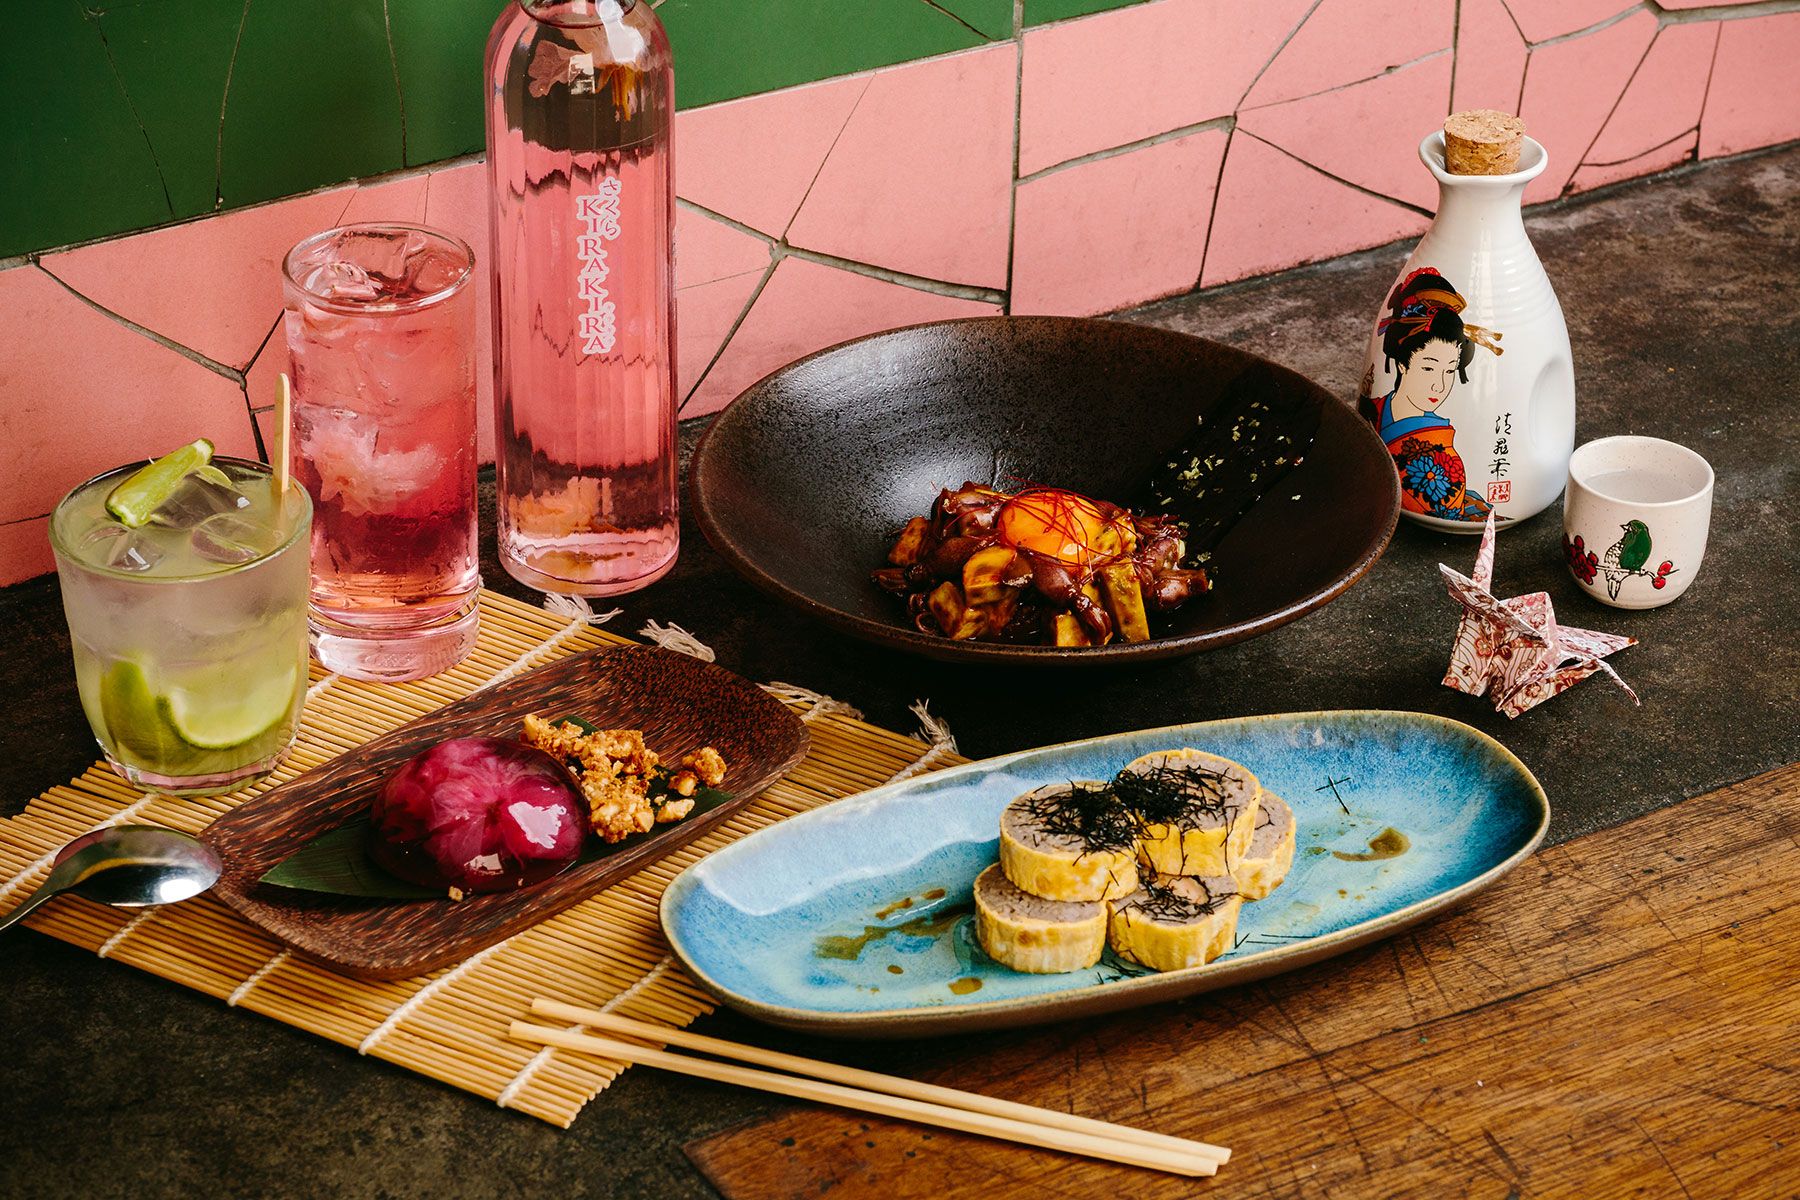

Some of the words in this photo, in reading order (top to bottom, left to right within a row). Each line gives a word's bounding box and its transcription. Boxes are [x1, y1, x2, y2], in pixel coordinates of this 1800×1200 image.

[603, 179, 618, 237] さくら
[582, 198, 606, 351] KIRAKIRA
